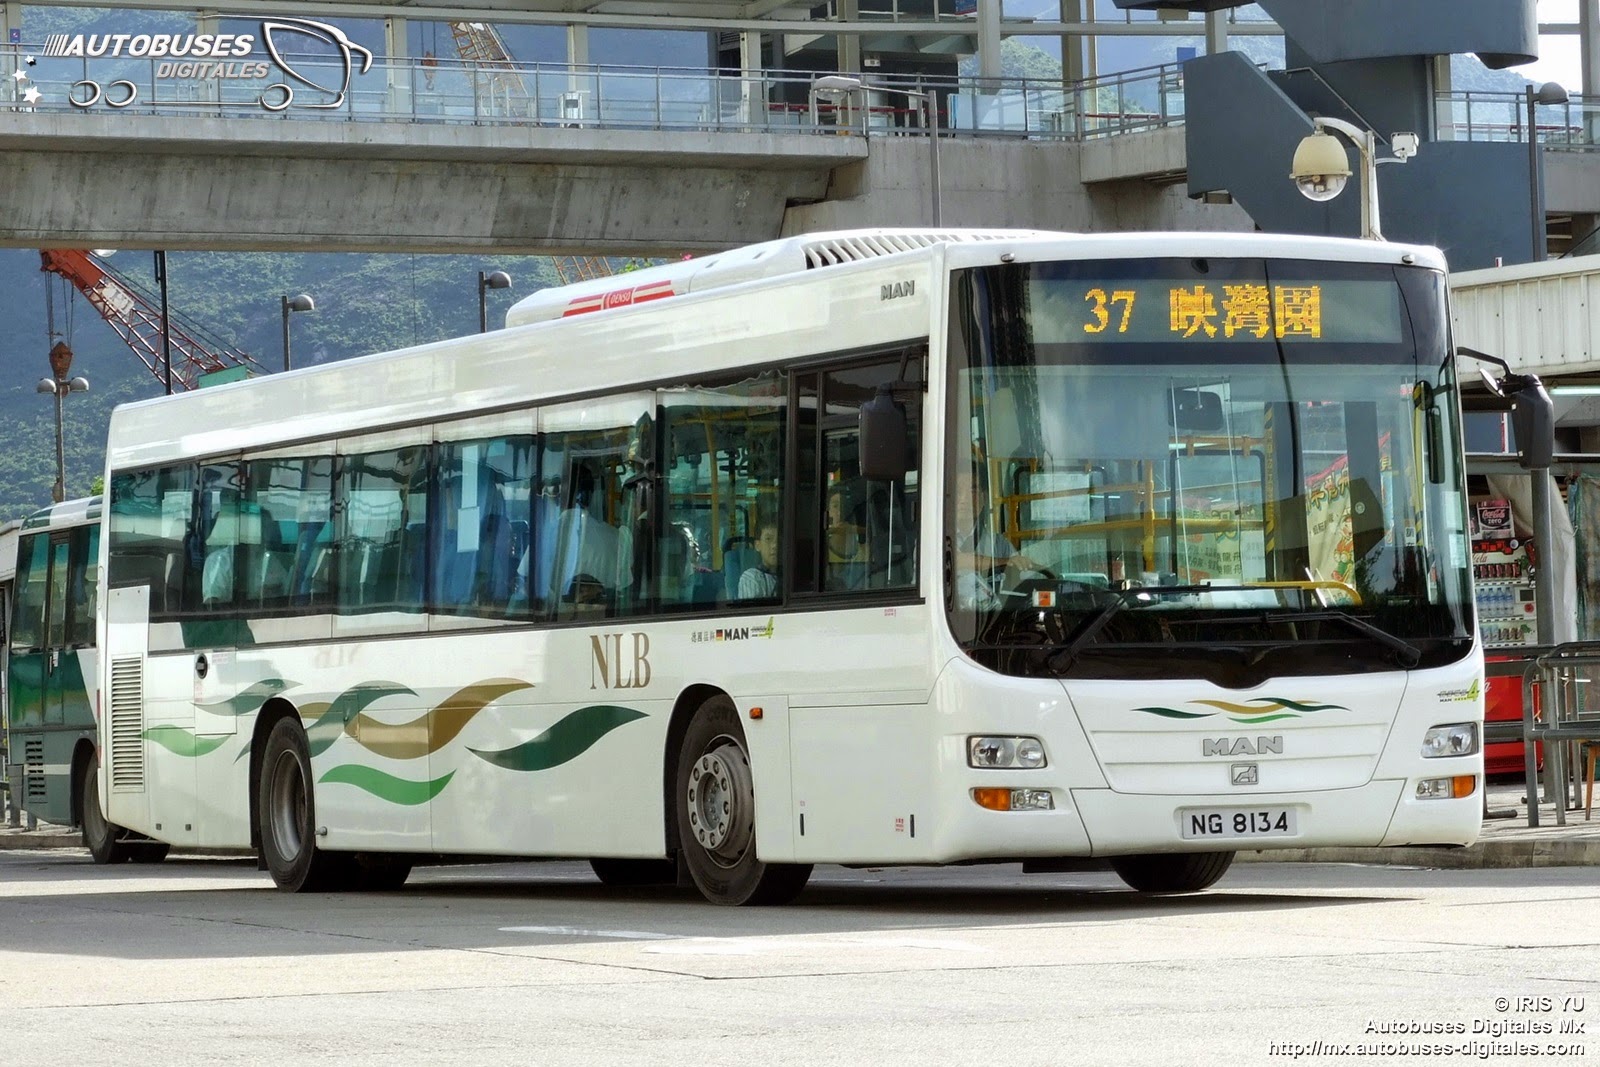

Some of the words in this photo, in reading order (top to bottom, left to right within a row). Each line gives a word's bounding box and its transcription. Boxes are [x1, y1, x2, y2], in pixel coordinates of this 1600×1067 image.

[610, 291, 631, 305] DENSO
[880, 280, 915, 301] MAN
[1084, 288, 1136, 333] 37
[1169, 284, 1321, 339] 映灣園
[724, 627, 749, 641] MAN
[589, 632, 652, 690] NLB
[1202, 736, 1284, 757] MAN
[1191, 813, 1223, 835] NG
[1233, 811, 1288, 833] 8134
